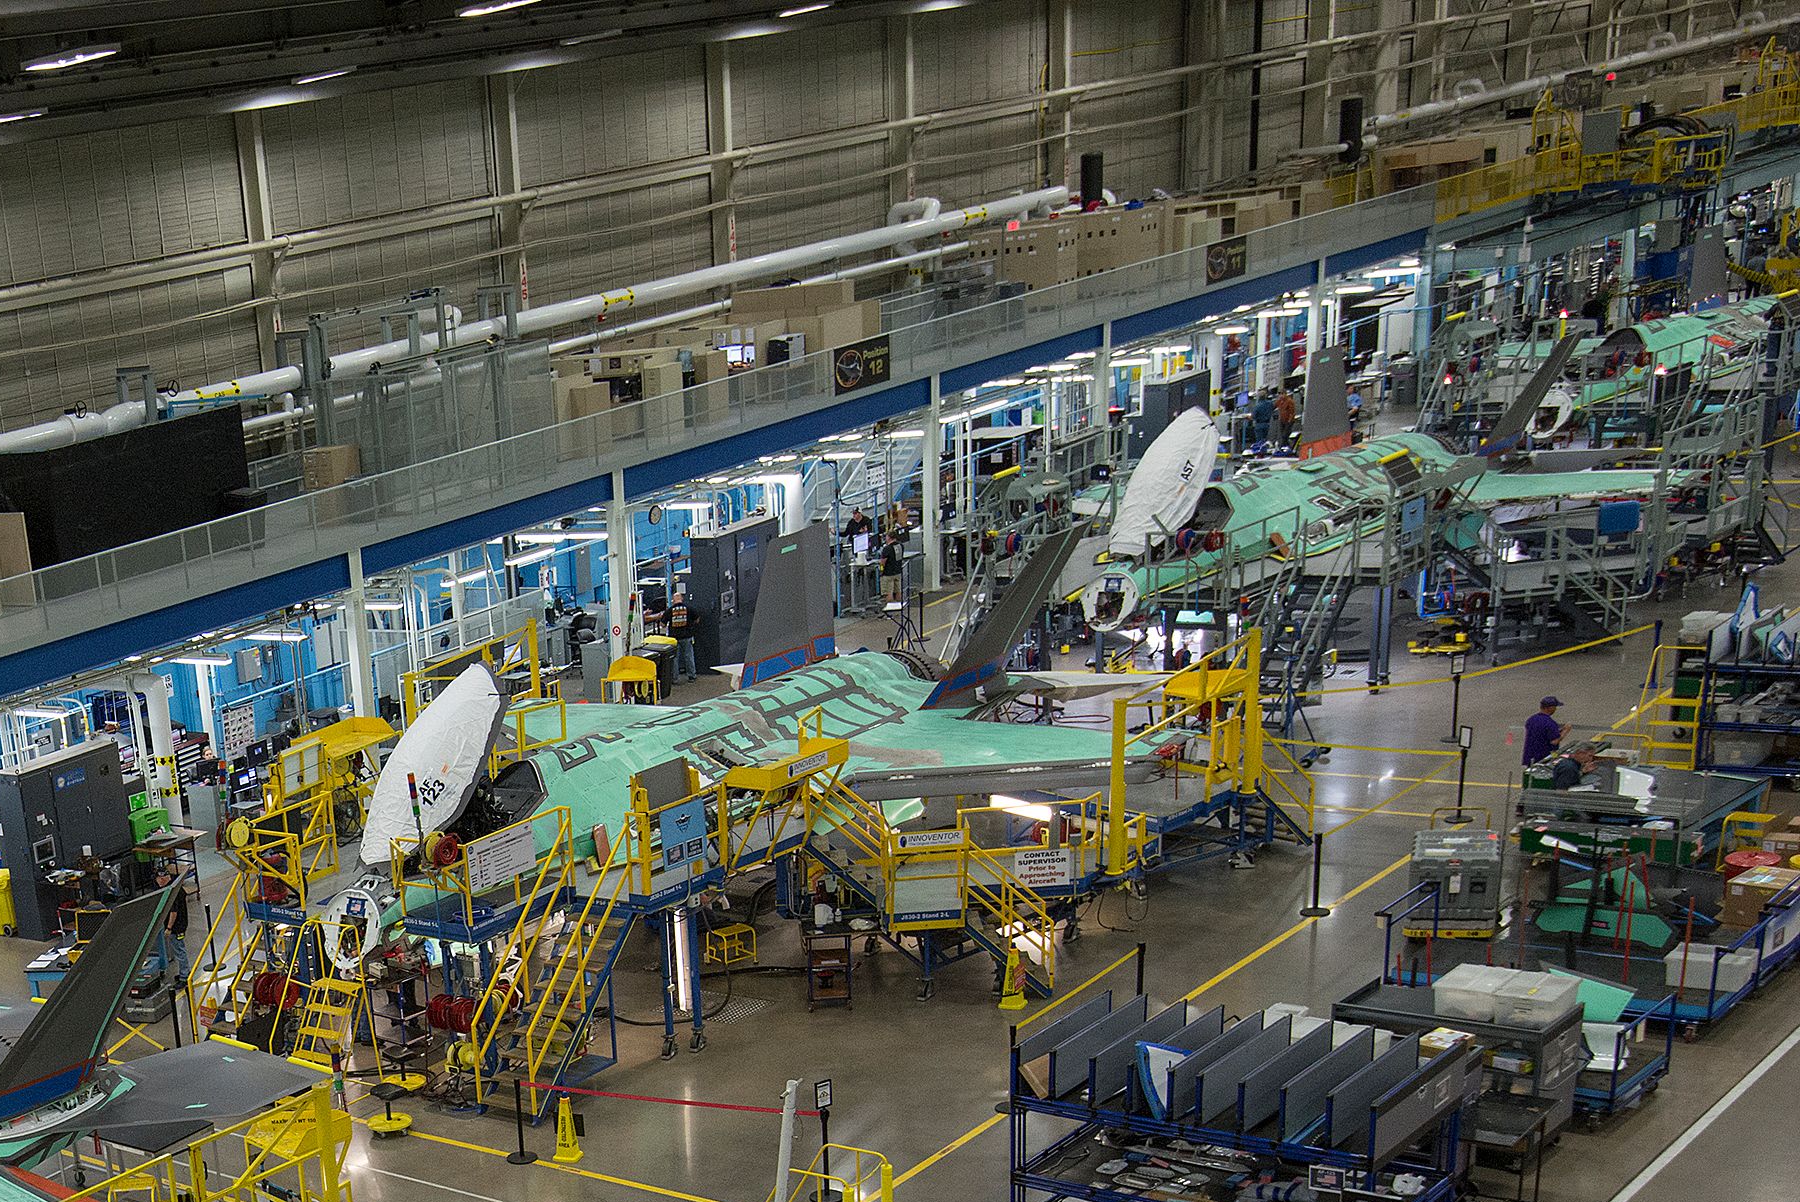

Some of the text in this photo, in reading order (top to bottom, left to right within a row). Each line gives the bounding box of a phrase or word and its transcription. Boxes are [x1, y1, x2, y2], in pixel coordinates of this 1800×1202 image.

[869, 358, 883, 376] 12
[419, 779, 432, 797] AF
[422, 779, 446, 807] 123
[1024, 850, 1060, 859] CONTACT
[1018, 857, 1067, 866] SUPERVISOR
[1019, 871, 1065, 880] Approaching
[1028, 877, 1056, 885] Aircraft
[921, 912, 939, 920] Stand
